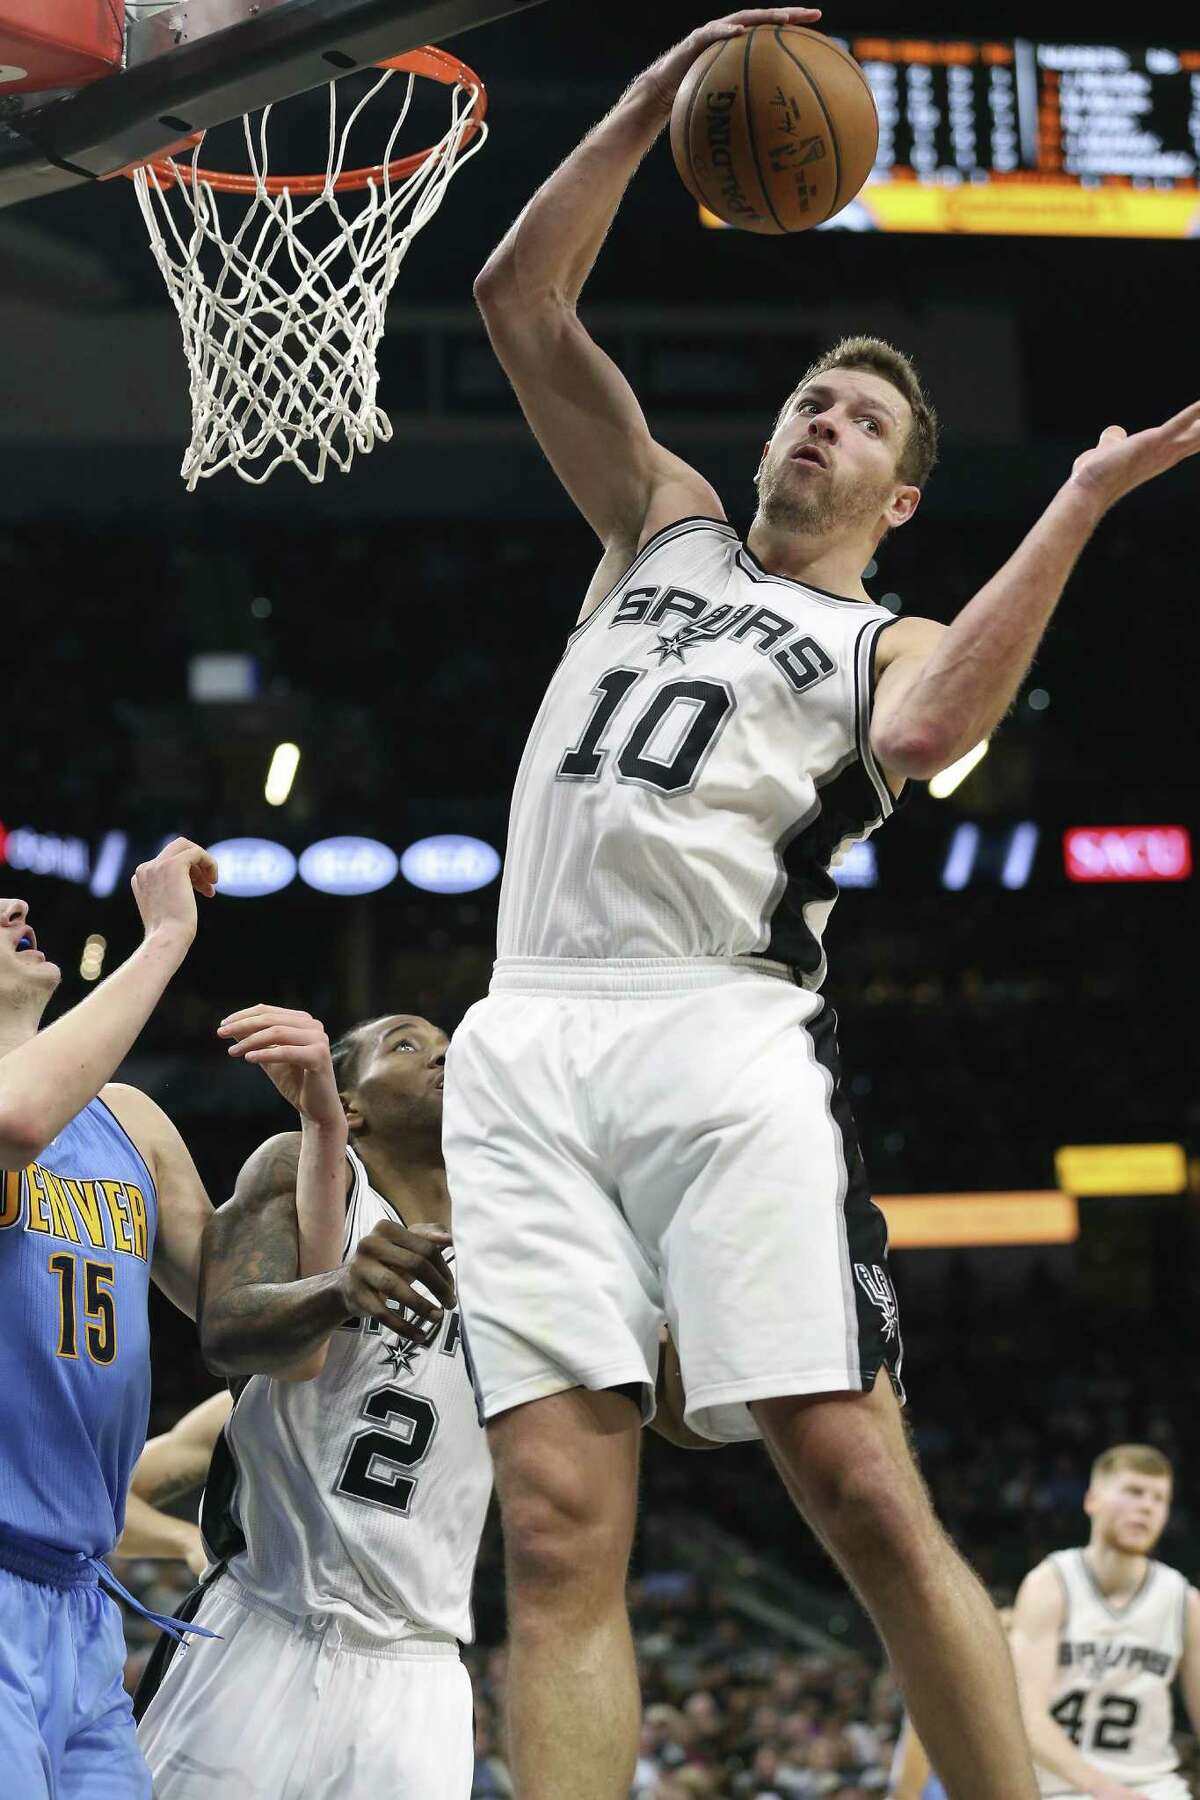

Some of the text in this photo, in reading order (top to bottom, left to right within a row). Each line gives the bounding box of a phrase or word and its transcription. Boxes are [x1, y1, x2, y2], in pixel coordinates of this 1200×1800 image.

[609, 586, 838, 693] SPURS
[556, 665, 737, 798] 10
[49, 1251, 117, 1366] 15
[331, 1383, 440, 1519] 2
[1058, 1642, 1173, 1678] SPURS
[1050, 1687, 1141, 1751] 42
